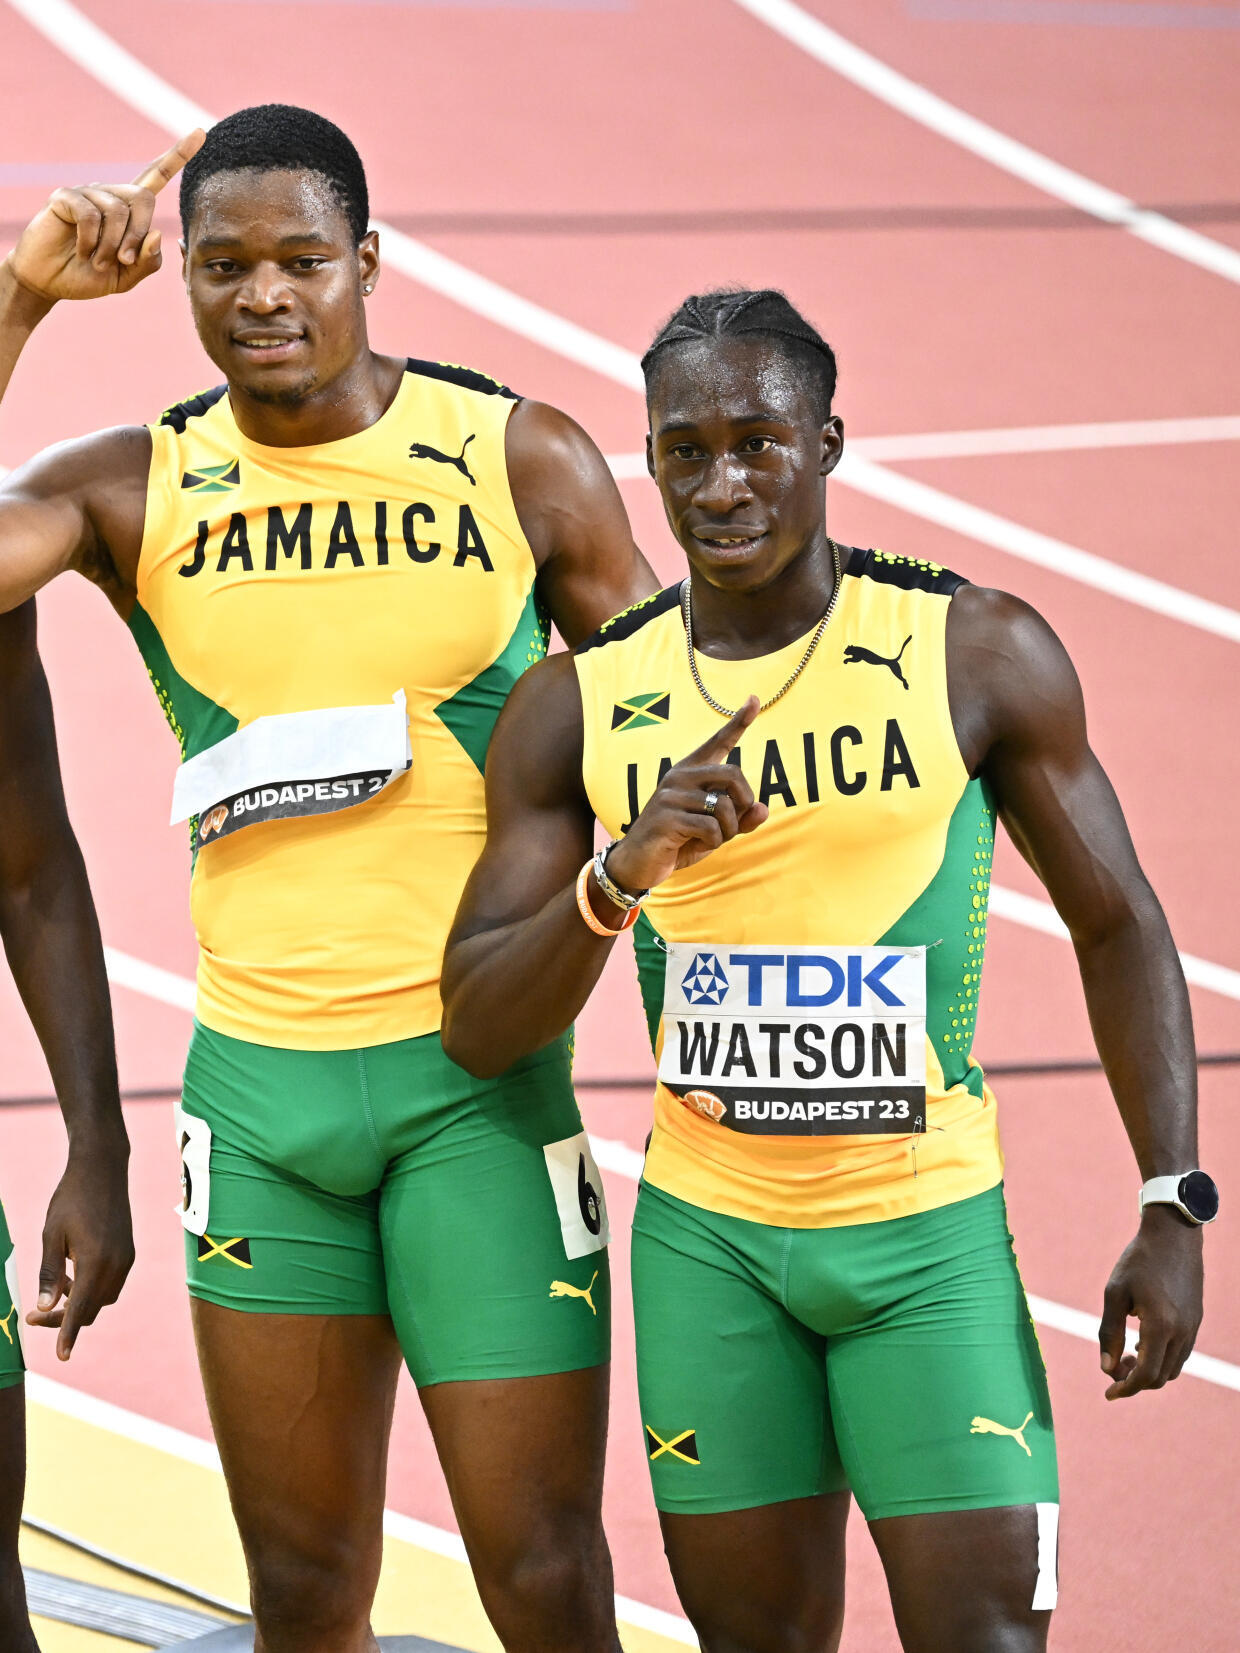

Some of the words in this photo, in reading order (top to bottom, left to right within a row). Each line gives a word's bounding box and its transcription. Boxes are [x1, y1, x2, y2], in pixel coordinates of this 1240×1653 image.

[178, 501, 495, 578] JAMAICA
[233, 778, 364, 818] BUDAPEST
[368, 775, 391, 793] 2
[620, 718, 921, 835] JAICA
[729, 954, 906, 1008] TDK
[677, 1021, 906, 1080] WATSON
[734, 1100, 875, 1121] BUDAPEST
[878, 1099, 910, 1119] 23
[577, 1151, 601, 1236] 6
